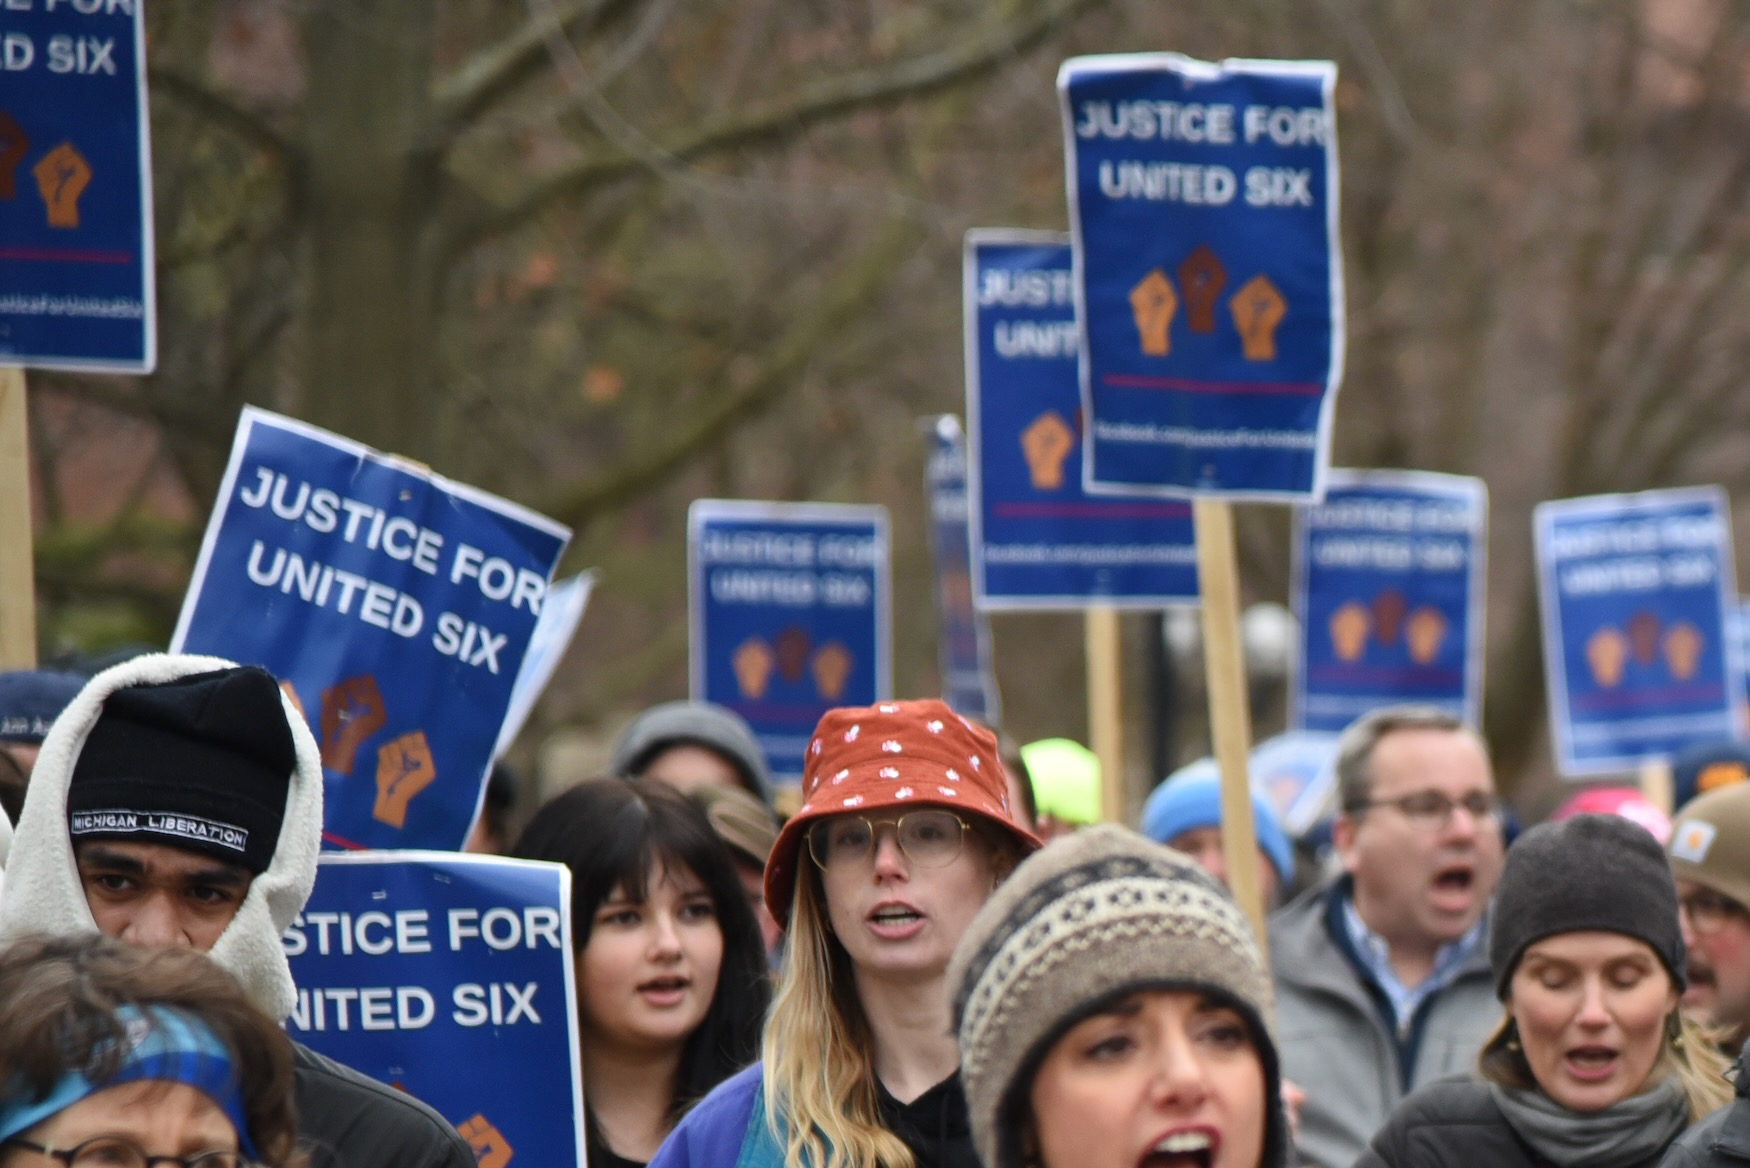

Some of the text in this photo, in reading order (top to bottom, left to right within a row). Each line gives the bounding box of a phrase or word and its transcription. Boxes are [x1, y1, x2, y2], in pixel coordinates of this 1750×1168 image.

[47, 32, 117, 75] SIX
[1077, 101, 1327, 146] JUSTICE FOR
[1099, 160, 1314, 207] UNITED SIX
[993, 320, 1081, 357] UNIT
[240, 467, 550, 616] JUSTICE FOR
[247, 541, 508, 675] UNITED SIX
[73, 815, 244, 846] MICHIGAN LIBERATION
[282, 907, 561, 956] STICE FOR
[281, 982, 541, 1031] NITED SIX
